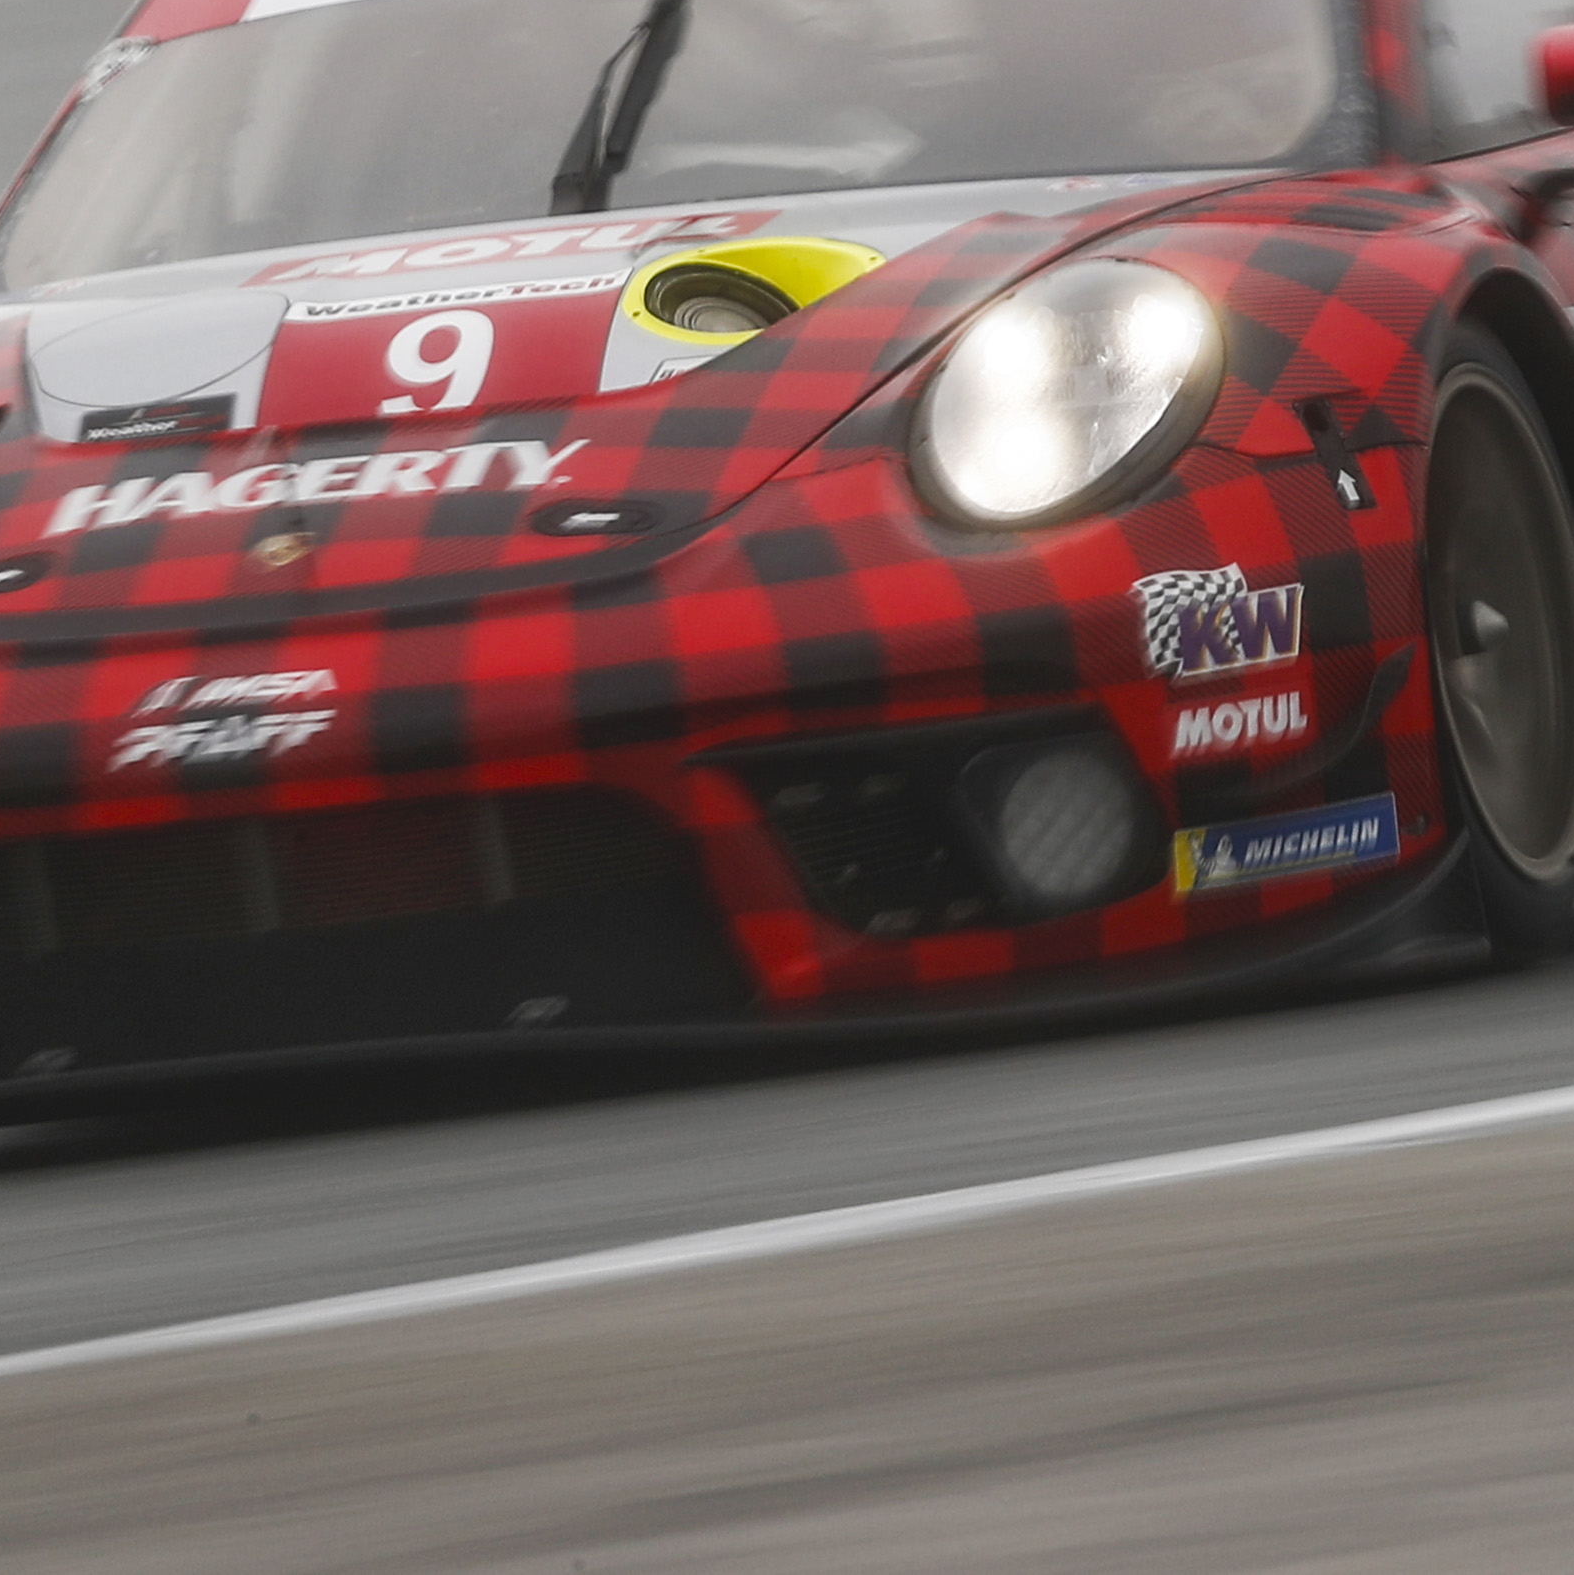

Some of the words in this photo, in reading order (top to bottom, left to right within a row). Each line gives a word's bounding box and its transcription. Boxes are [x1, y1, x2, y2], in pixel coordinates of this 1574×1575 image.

[306, 275, 618, 317] WeatherTech
[377, 309, 495, 416] 9
[40, 438, 589, 538] HAGERTY
[1178, 586, 1300, 673] KW
[1175, 691, 1308, 753] MOTUL
[1244, 817, 1379, 862] MICHELIN
